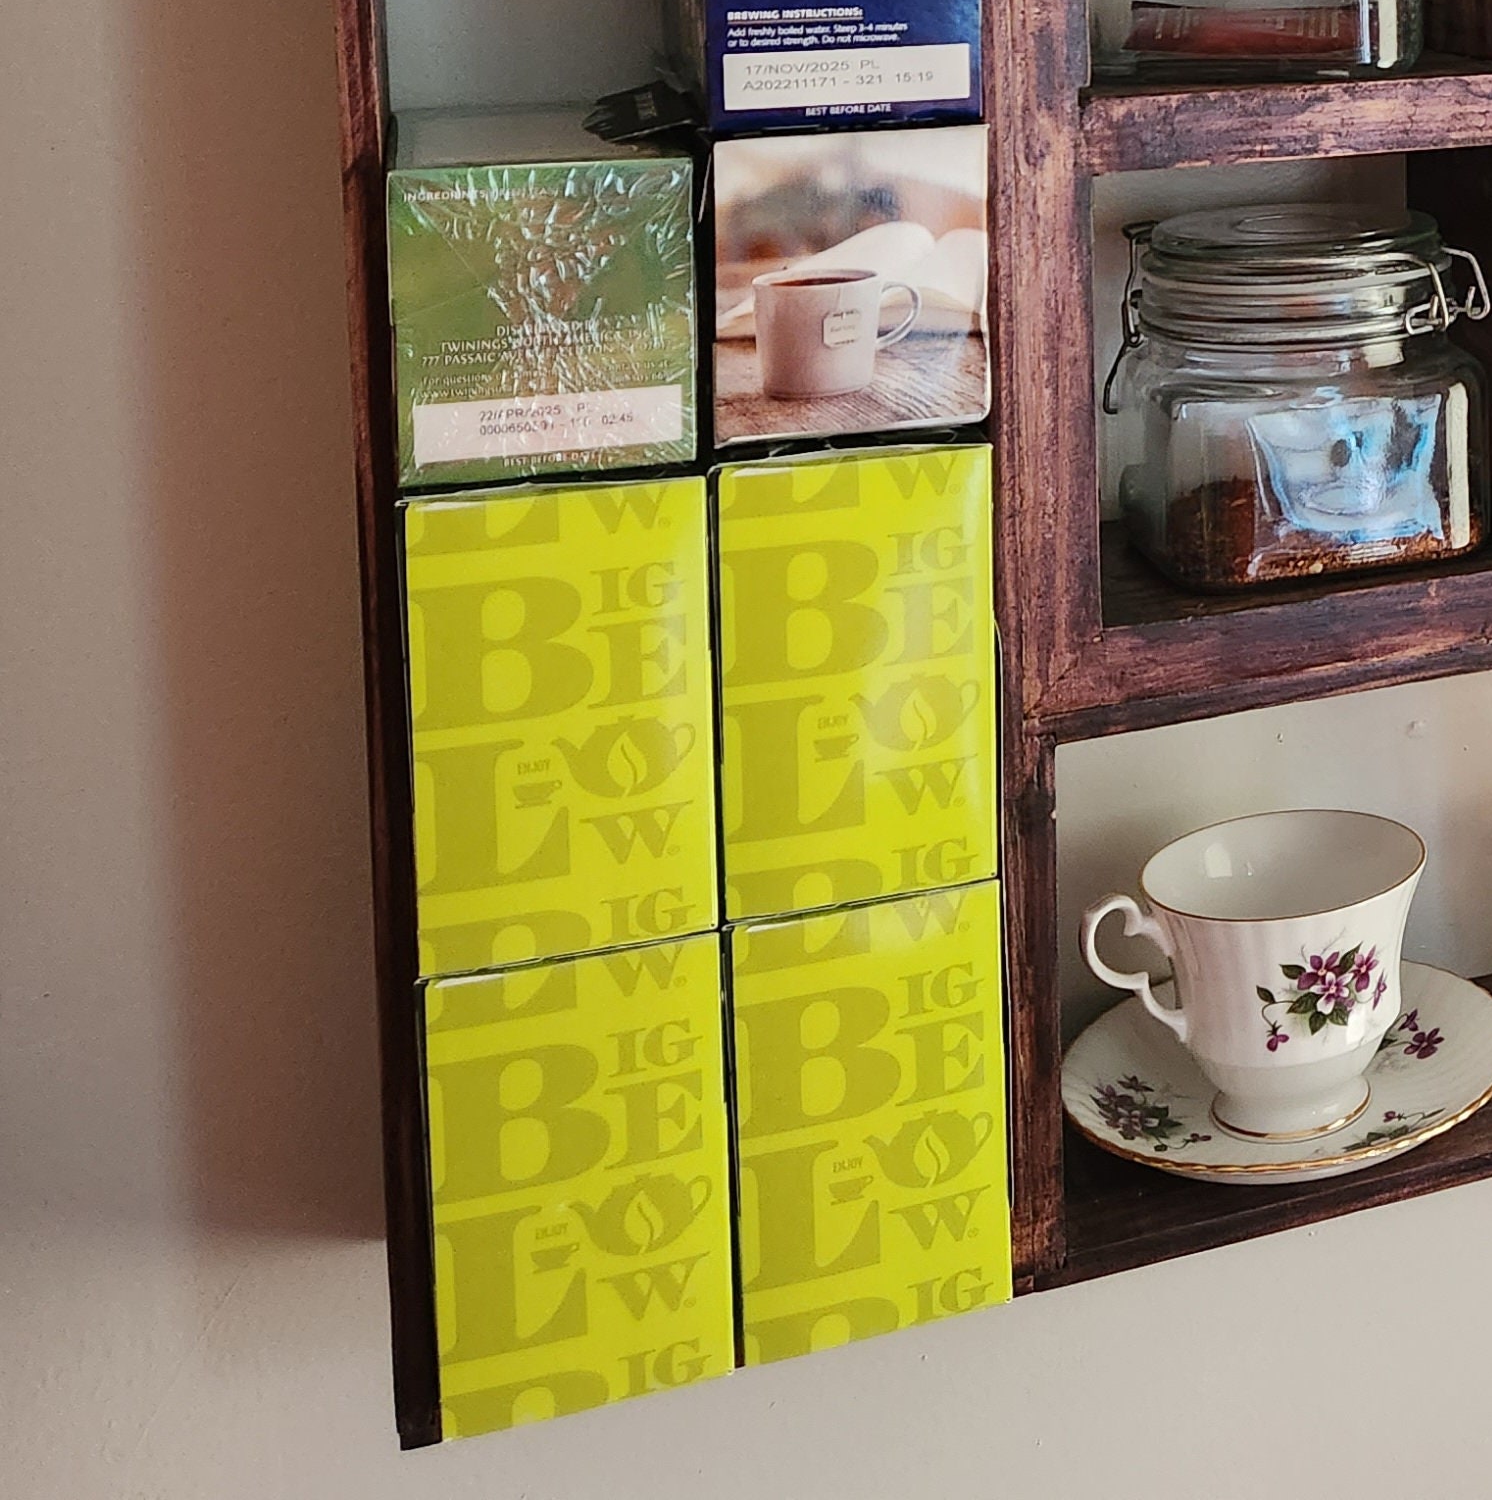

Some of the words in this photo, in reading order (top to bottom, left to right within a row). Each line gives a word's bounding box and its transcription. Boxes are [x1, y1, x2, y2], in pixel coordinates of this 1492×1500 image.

[727, 9, 780, 21] BREWING
[782, 6, 863, 19] INSTRUCTIONS:
[727, 27, 746, 38] Add
[748, 26, 776, 38] freshly
[778, 25, 804, 36] boiled
[833, 24, 857, 35] Steep
[859, 23, 873, 32] 3-4
[875, 22, 908, 31] minutes
[727, 39, 737, 48] or
[738, 38, 749, 47] to
[750, 37, 781, 47] desired
[783, 36, 820, 47] strength.
[822, 35, 835, 44] Do
[837, 34, 851, 44] not
[852, 33, 900, 43] microwave.
[745, 61, 850, 76] 17/NOV/2025
[860, 59, 880, 70] PL
[742, 77, 837, 92] A202211171
[855, 74, 883, 86] 321
[805, 106, 828, 117] BEST
[829, 104, 865, 116] BEFORE
[867, 102, 892, 113] DATE
[444, 351, 496, 366] PASSAIC
